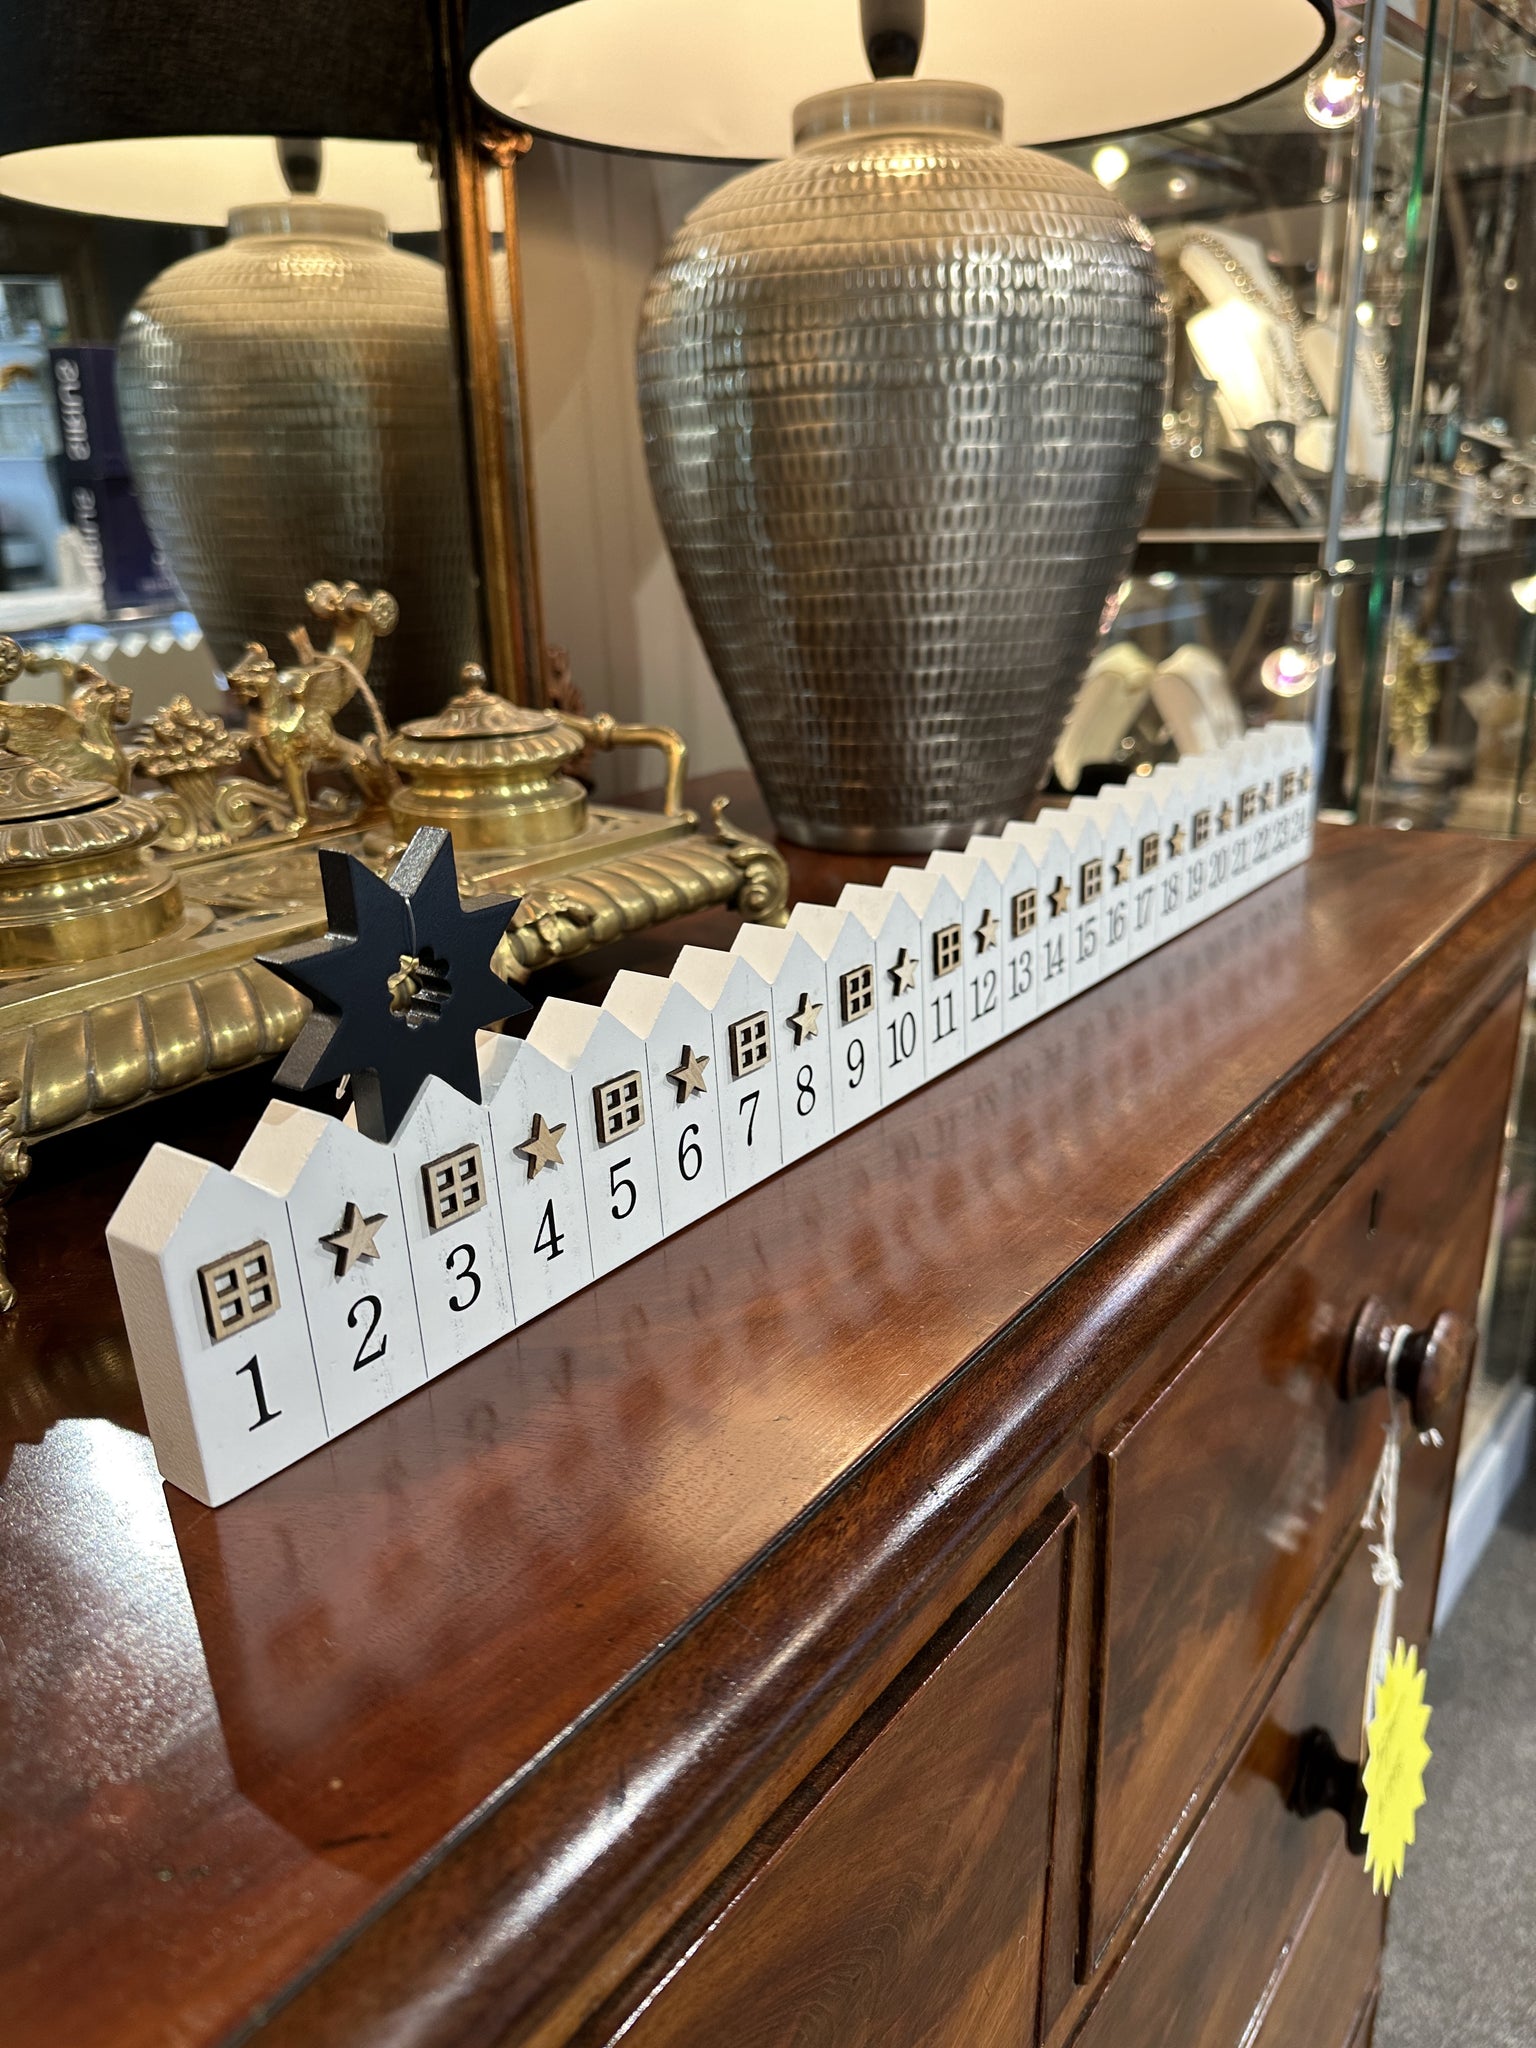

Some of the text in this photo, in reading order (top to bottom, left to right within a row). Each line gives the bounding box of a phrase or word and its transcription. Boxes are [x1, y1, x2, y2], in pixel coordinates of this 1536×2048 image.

[236, 1354, 282, 1431] 1
[347, 1295, 387, 1371] 2
[446, 1244, 481, 1311] 3
[534, 1199, 564, 1261] 4
[610, 1157, 636, 1219] 5
[678, 1123, 702, 1181] 6
[739, 1090, 760, 1146] 7
[796, 1064, 816, 1116] 8
[847, 1038, 864, 1088] 9
[887, 1011, 916, 1068] 10
[931, 990, 958, 1043] 11
[970, 969, 997, 1022] 12
[1008, 950, 1032, 1000] 13
[1043, 934, 1064, 981] 14
[1076, 917, 1096, 964] 15
[1106, 901, 1125, 947] 16
[1134, 887, 1154, 932] 17
[1161, 872, 1179, 916] 18
[1186, 860, 1204, 903] 19
[1208, 848, 1227, 889] 20
[1231, 837, 1248, 877] 21
[1252, 826, 1270, 865] 22
